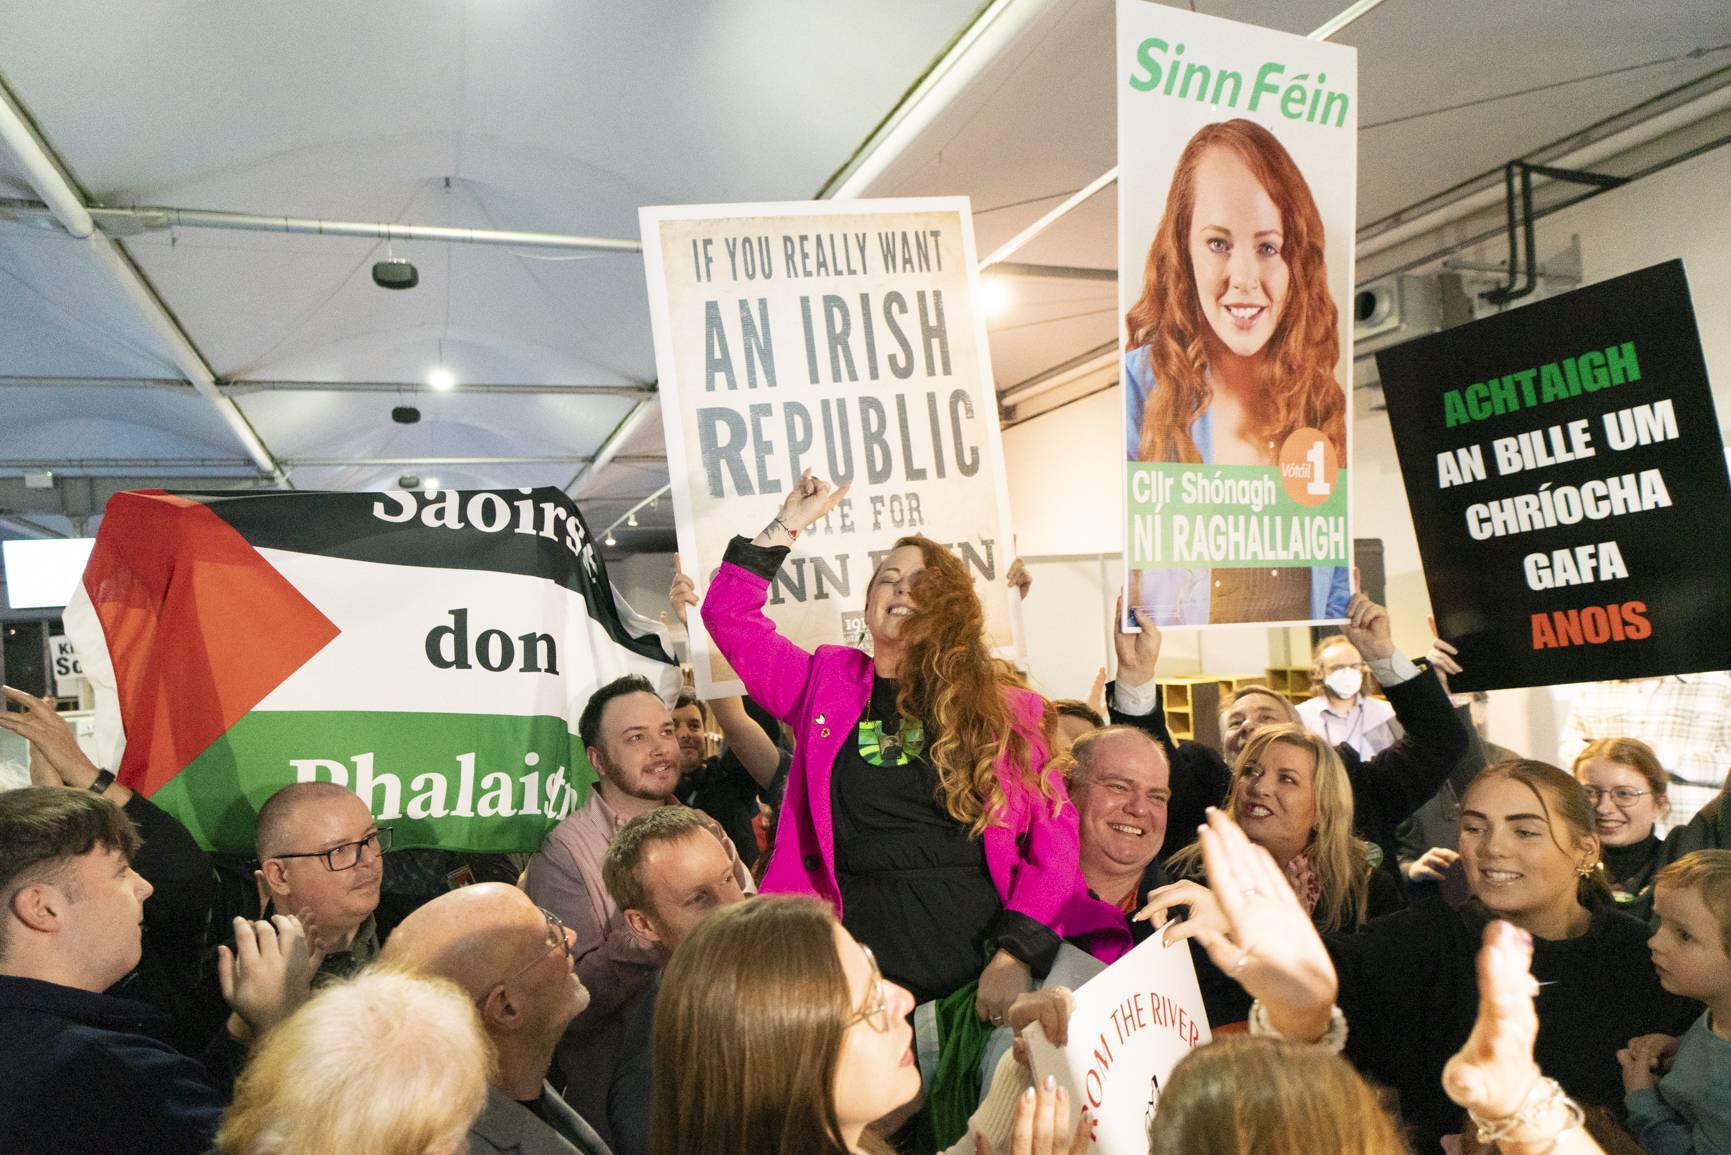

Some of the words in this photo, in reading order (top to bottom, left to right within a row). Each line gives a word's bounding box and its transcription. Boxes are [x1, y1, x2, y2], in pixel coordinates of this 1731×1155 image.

[1129, 37, 1243, 108] Sinn
[1247, 62, 1349, 128] Féin
[692, 238, 714, 282] IF
[724, 236, 773, 281] YOU
[783, 233, 868, 278] REALLY
[878, 230, 942, 273] WANT
[705, 297, 777, 392] AN
[799, 289, 953, 385] IRISH
[1443, 341, 1642, 428] ACHTAIGH
[696, 388, 980, 498] REPUBLIC
[1306, 441, 1330, 495] 1
[1437, 444, 1486, 489] AN
[1492, 419, 1596, 476] BILLE
[1603, 399, 1680, 452] UM
[870, 492, 925, 532] FOR
[1132, 470, 1174, 503] Cllr
[1181, 470, 1276, 512] Shónagh
[1465, 468, 1673, 541] CHRÍOCHA
[1134, 504, 1162, 562] NÍ
[1172, 515, 1345, 561] RAGHALLAIGH
[1523, 541, 1629, 591] GAFA
[425, 607, 560, 676] don
[1531, 601, 1653, 650] ANOIS
[1110, 993, 1146, 1045] THE
[1150, 992, 1199, 1047] RIVER
